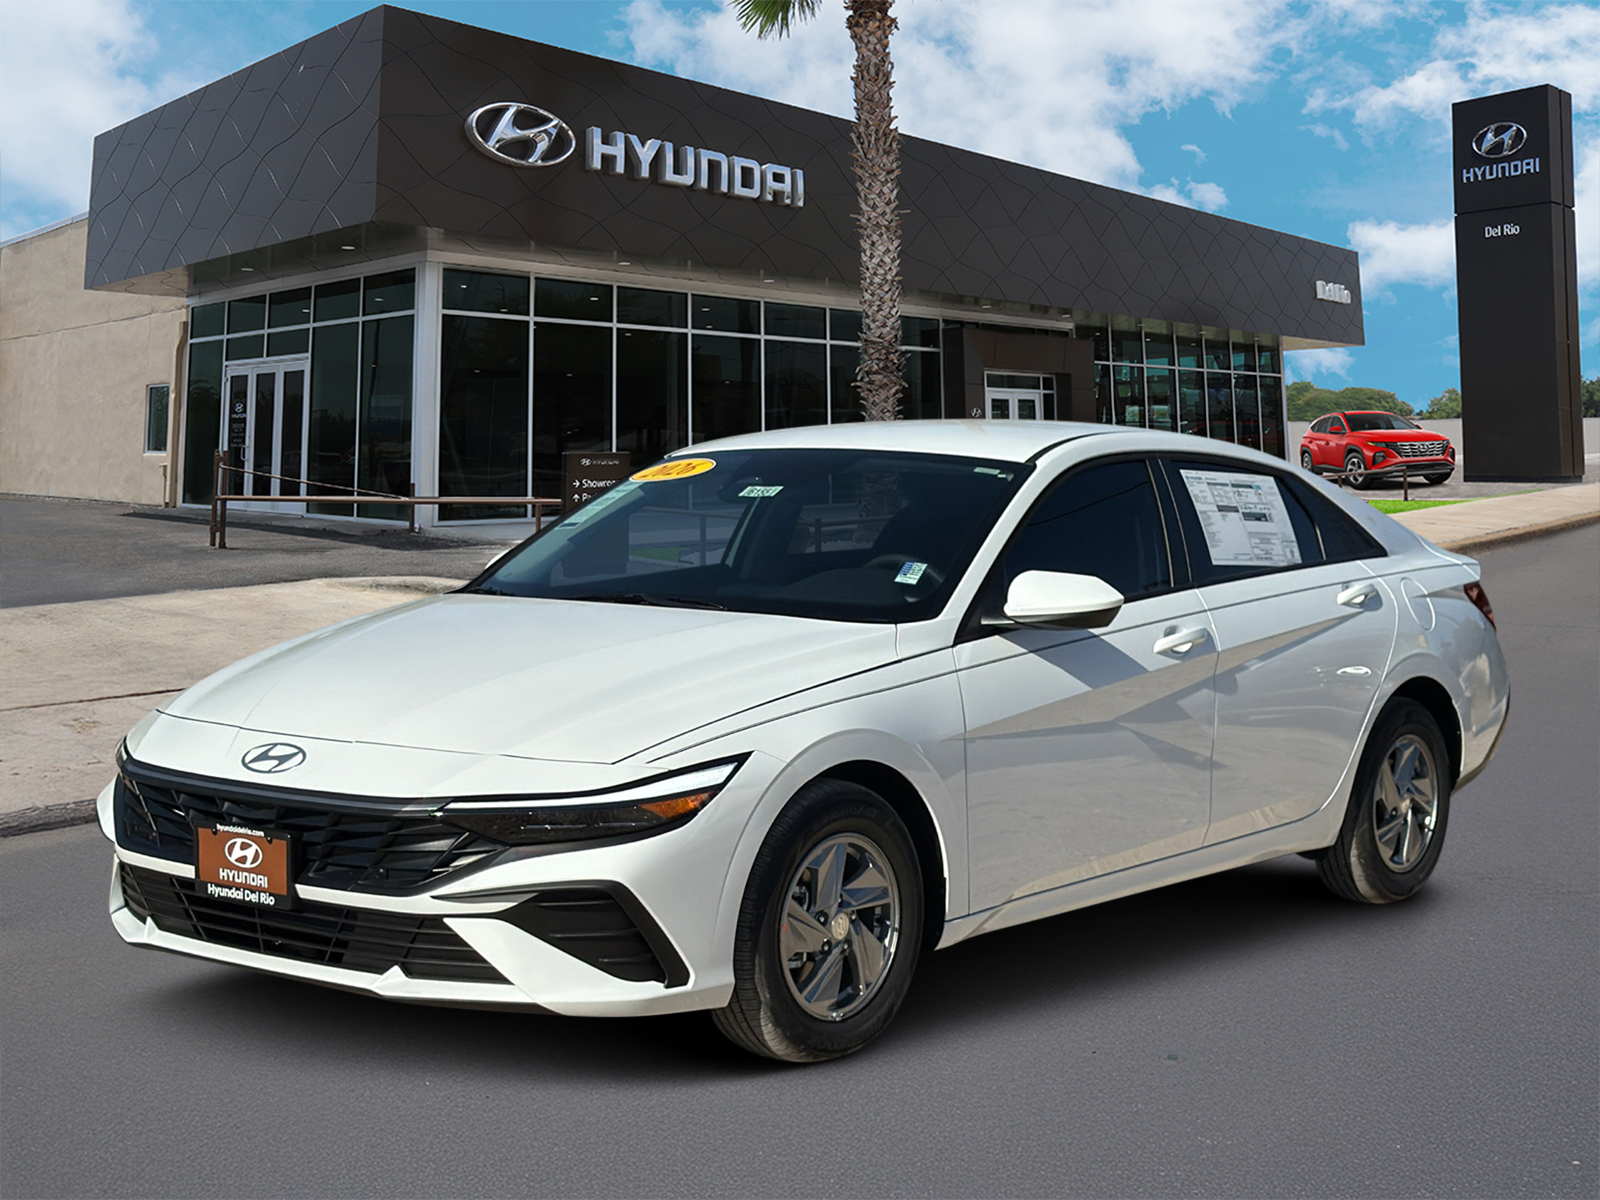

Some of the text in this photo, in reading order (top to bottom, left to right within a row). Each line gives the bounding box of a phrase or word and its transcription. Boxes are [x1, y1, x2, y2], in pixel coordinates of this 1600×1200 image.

[585, 126, 804, 207] HYUNDAI
[1462, 157, 1540, 183] HYUNDAI
[1485, 223, 1520, 238] Del Rio
[217, 823, 265, 837] hyundaidelrio.com
[219, 868, 268, 888] HYUNDAI
[207, 883, 275, 905] Hyundai Del Rio
